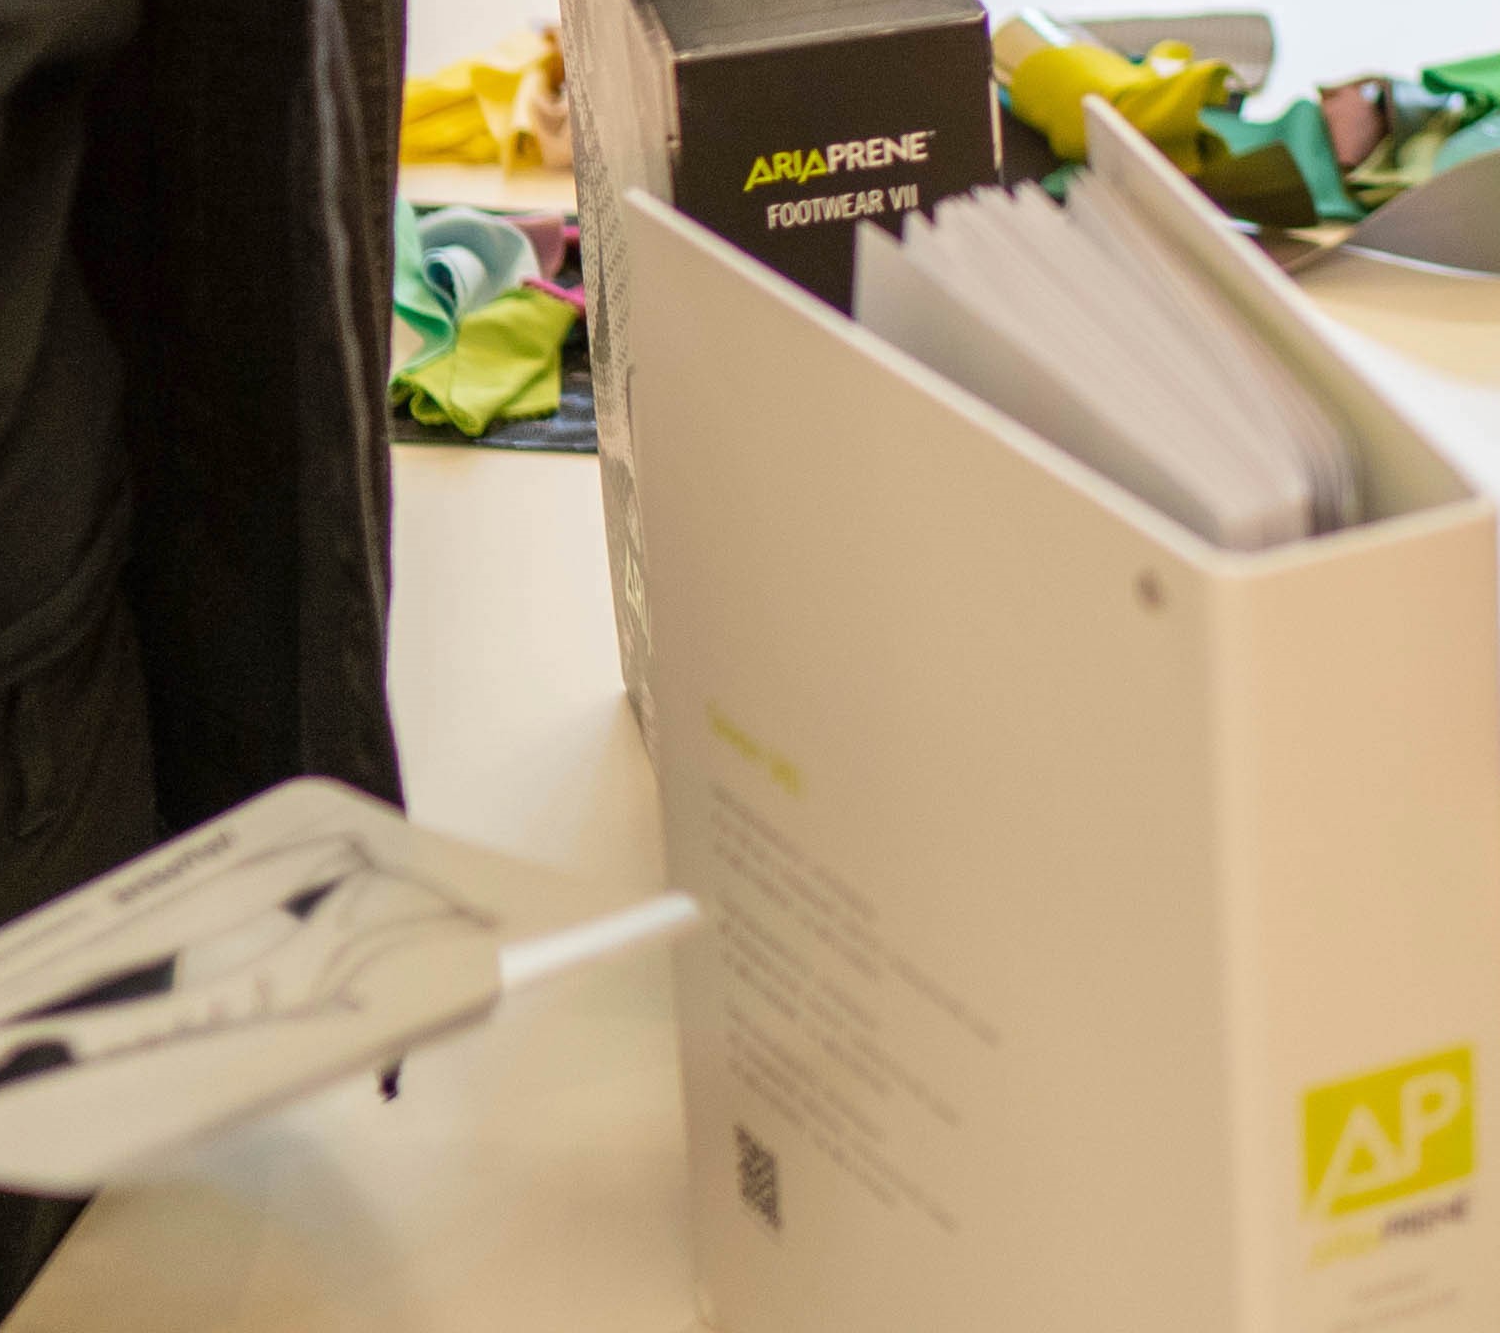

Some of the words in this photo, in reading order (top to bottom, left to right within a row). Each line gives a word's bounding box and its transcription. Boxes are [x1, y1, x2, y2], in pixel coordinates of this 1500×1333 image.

[743, 131, 930, 192] ARIAPRENE
[767, 189, 884, 229] FOOTWEAR
[888, 183, 919, 211] VII
[1310, 1070, 1463, 1215] AP
